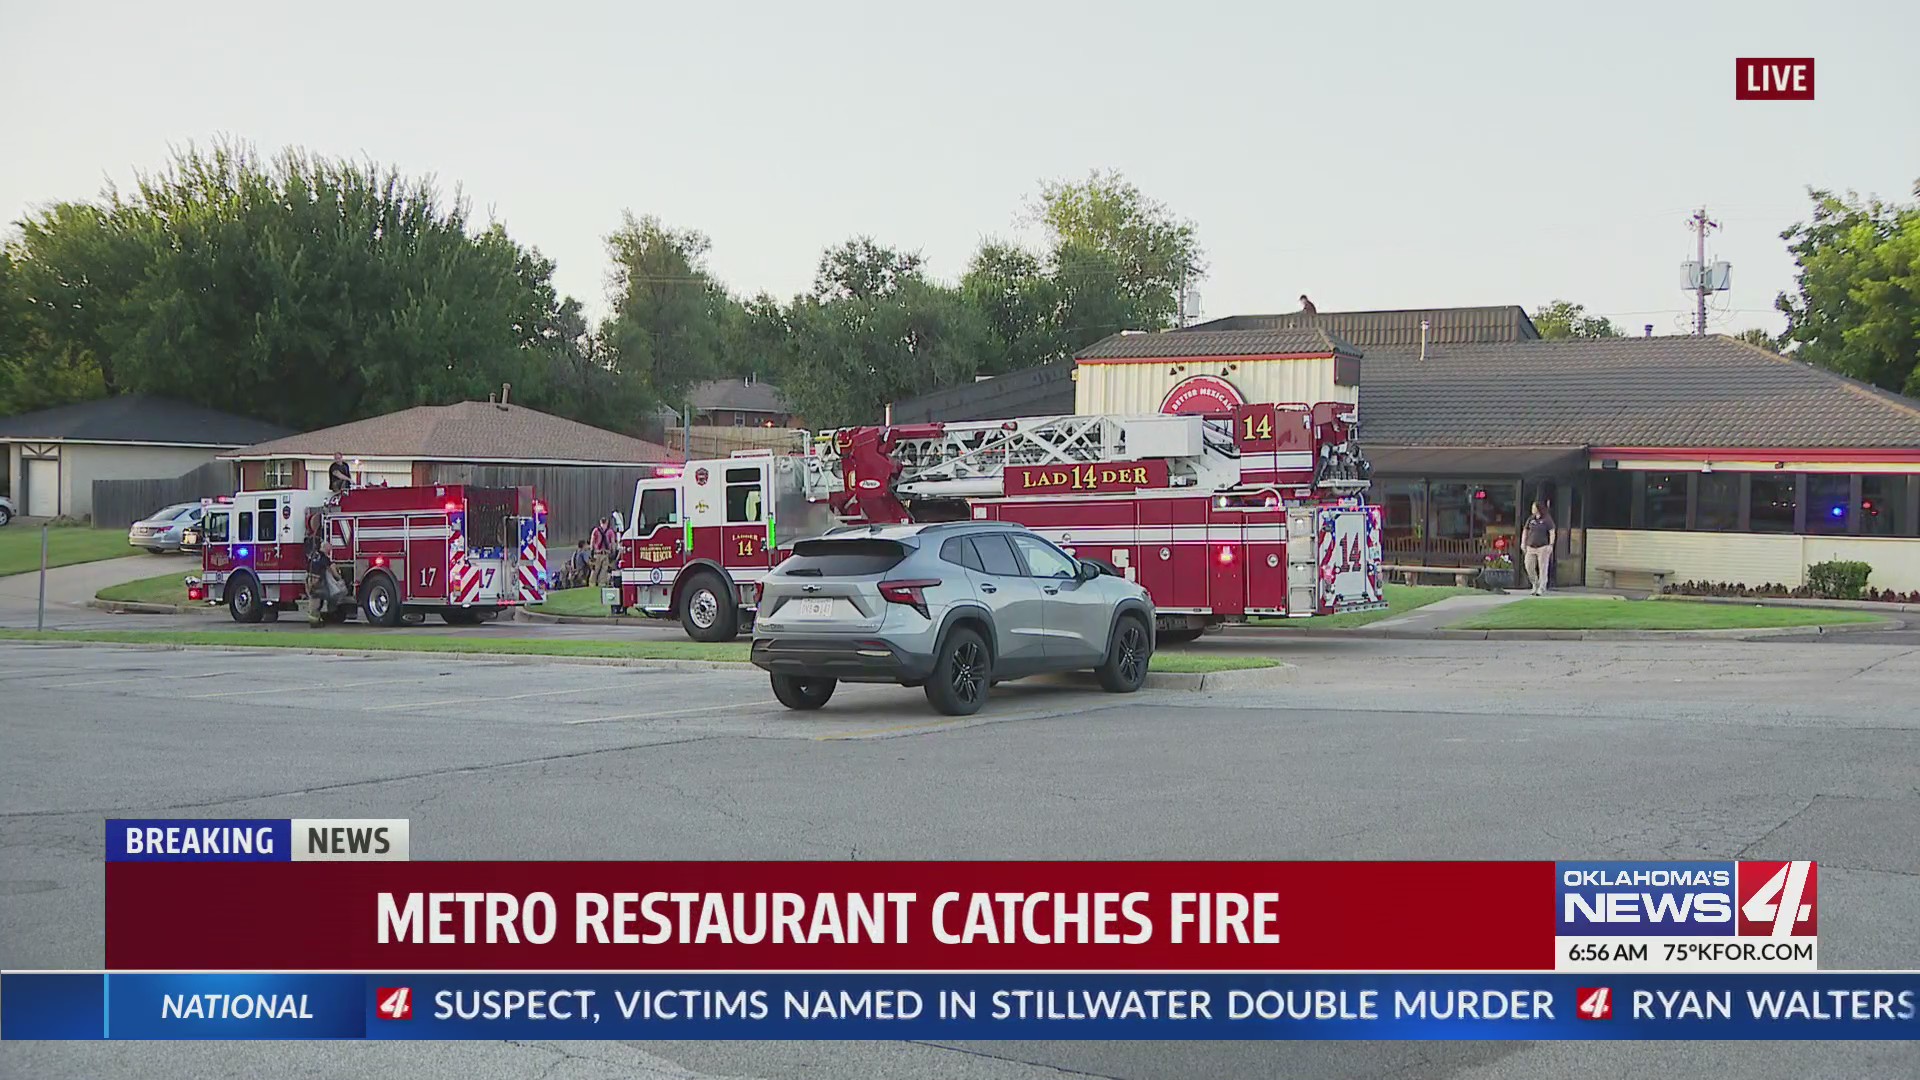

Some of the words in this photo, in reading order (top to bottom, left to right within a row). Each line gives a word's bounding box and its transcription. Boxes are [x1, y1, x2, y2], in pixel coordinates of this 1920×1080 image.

[1171, 388, 1198, 411] BETTER
[1243, 414, 1272, 441] 14
[1022, 471, 1068, 488] LAD
[1071, 465, 1097, 490] 14
[1101, 467, 1149, 485] DER
[738, 540, 753, 556] 14
[1339, 532, 1361, 572] 14
[420, 567, 437, 587] 17
[479, 567, 496, 588] 17
